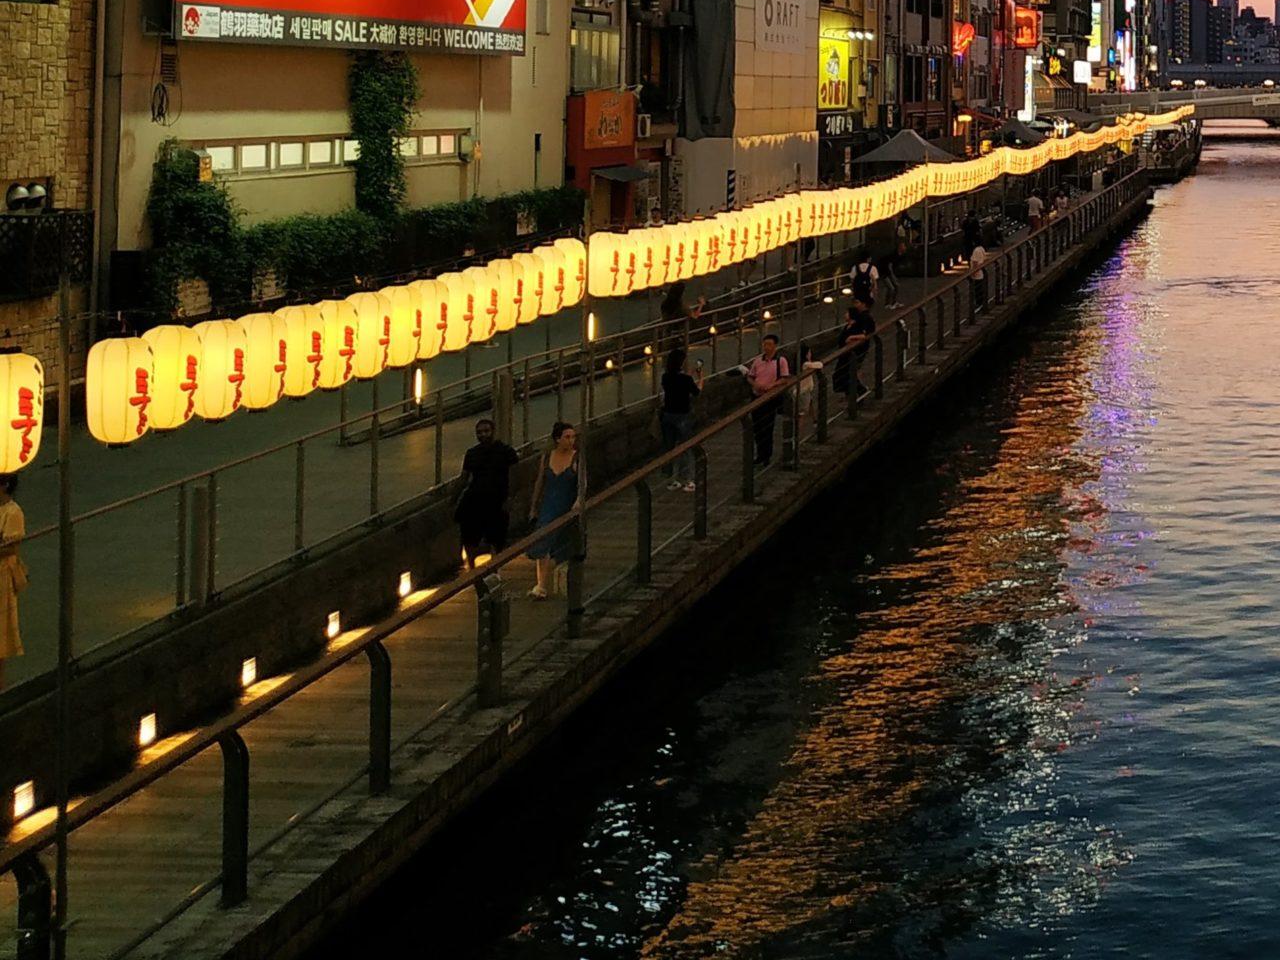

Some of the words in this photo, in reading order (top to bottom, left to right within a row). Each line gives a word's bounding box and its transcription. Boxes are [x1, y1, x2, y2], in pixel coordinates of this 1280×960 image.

[776, 0, 800, 31] RAFT
[334, 19, 368, 43] SALE
[398, 25, 442, 47] 환영합니다
[443, 27, 496, 51] WELCOME
